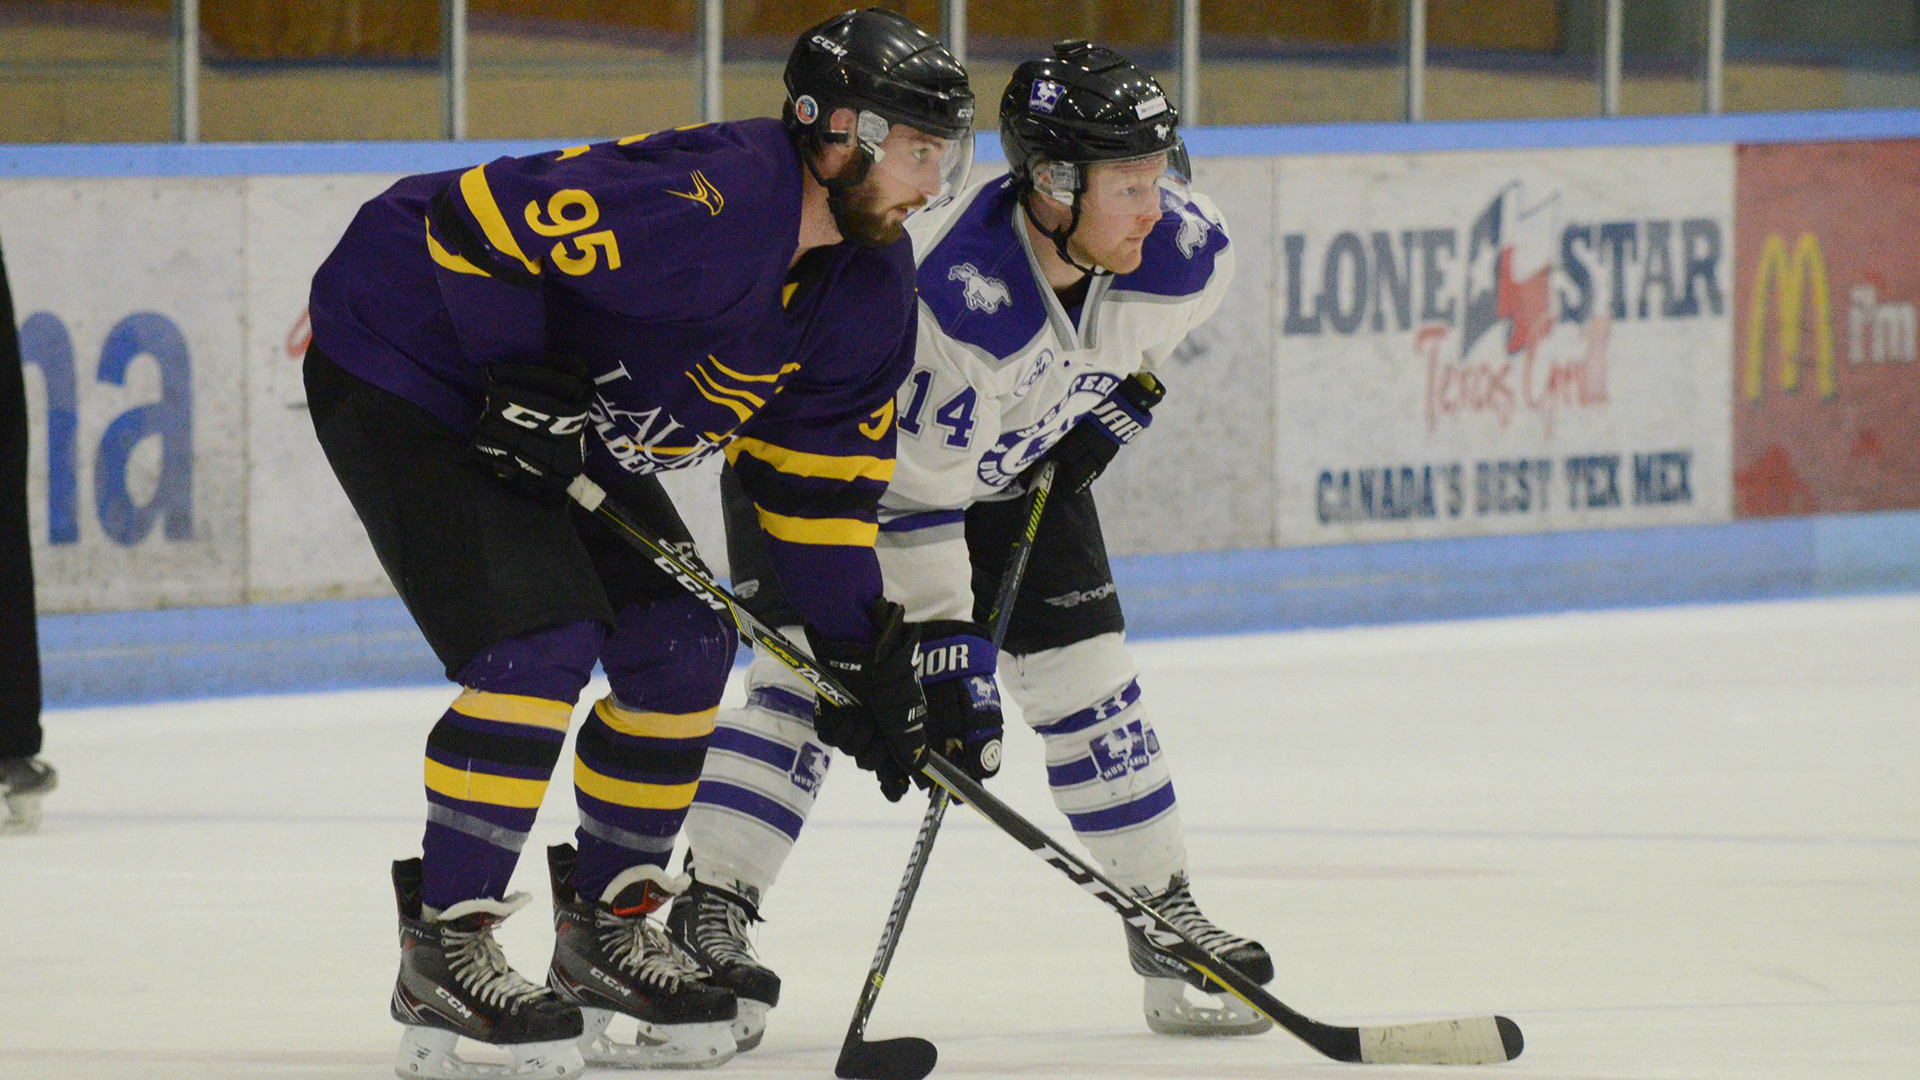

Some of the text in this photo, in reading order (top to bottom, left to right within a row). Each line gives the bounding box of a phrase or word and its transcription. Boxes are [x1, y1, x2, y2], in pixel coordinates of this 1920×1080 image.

[811, 35, 848, 57] CCM
[524, 188, 622, 276] 95
[1283, 218, 1729, 336] LONE STAR
[1414, 314, 1614, 436] Texas Grill
[898, 366, 979, 451] 14
[1316, 450, 1693, 525] CANADA'S BEST TEX MEX
[654, 556, 727, 611] CCM
[829, 660, 862, 671] CCM
[435, 986, 473, 1019] CCM
[591, 966, 632, 997] CCM
